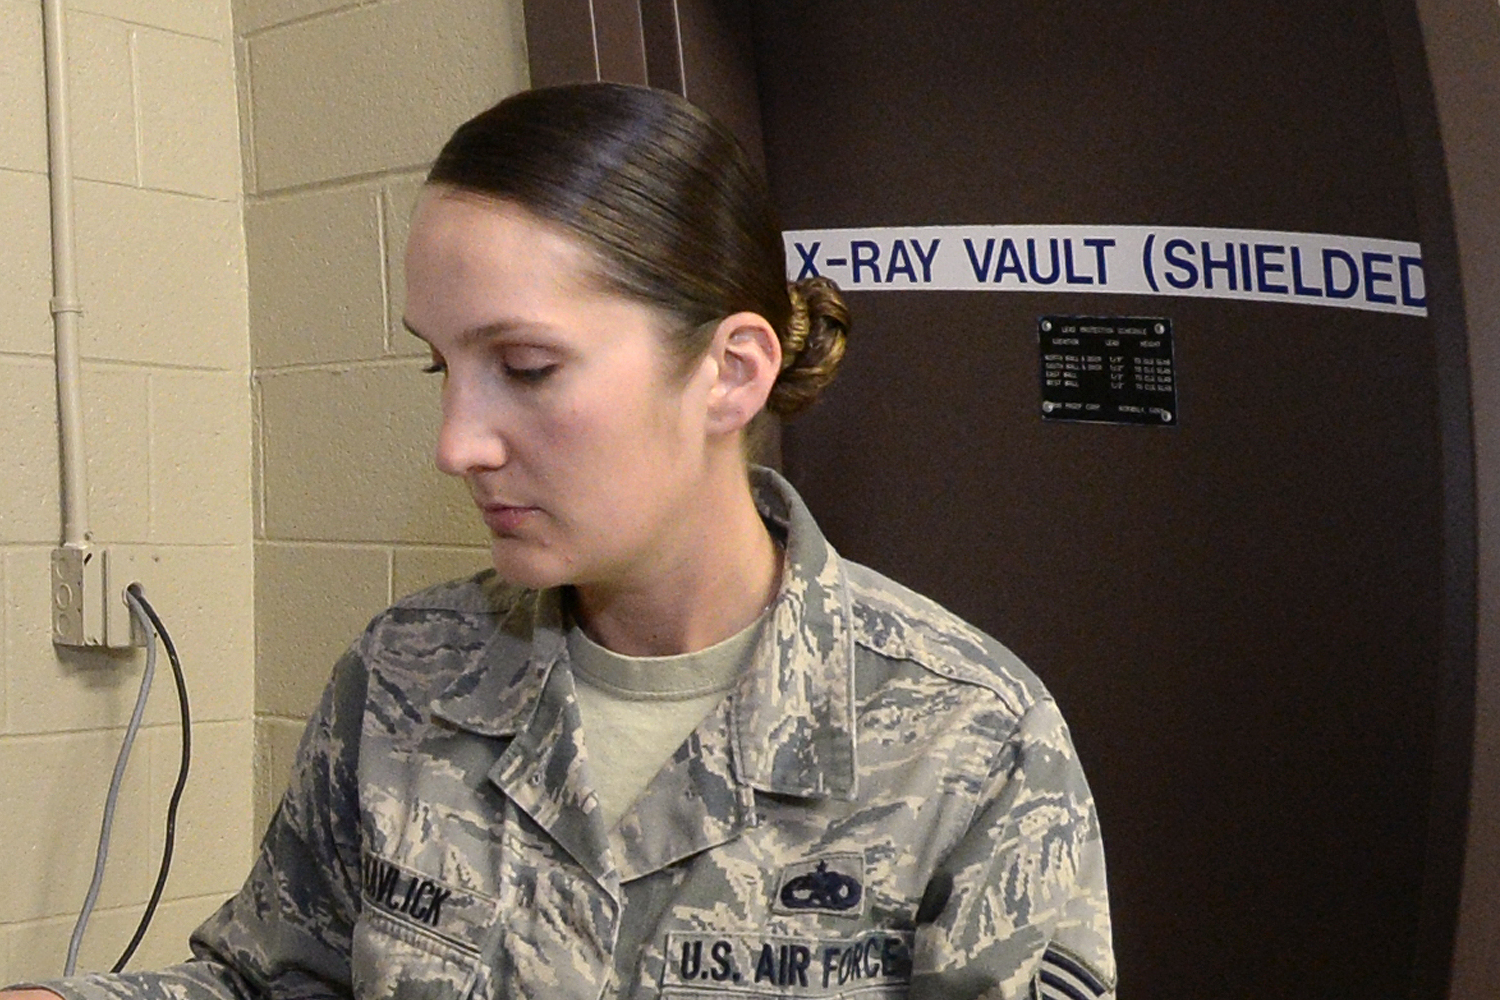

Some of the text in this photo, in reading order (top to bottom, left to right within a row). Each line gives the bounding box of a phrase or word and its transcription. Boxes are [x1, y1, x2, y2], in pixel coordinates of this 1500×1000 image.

[794, 233, 1427, 308] X-RAY VAULT (SHIELDED
[681, 937, 903, 989] U.S. AIR FORCE
